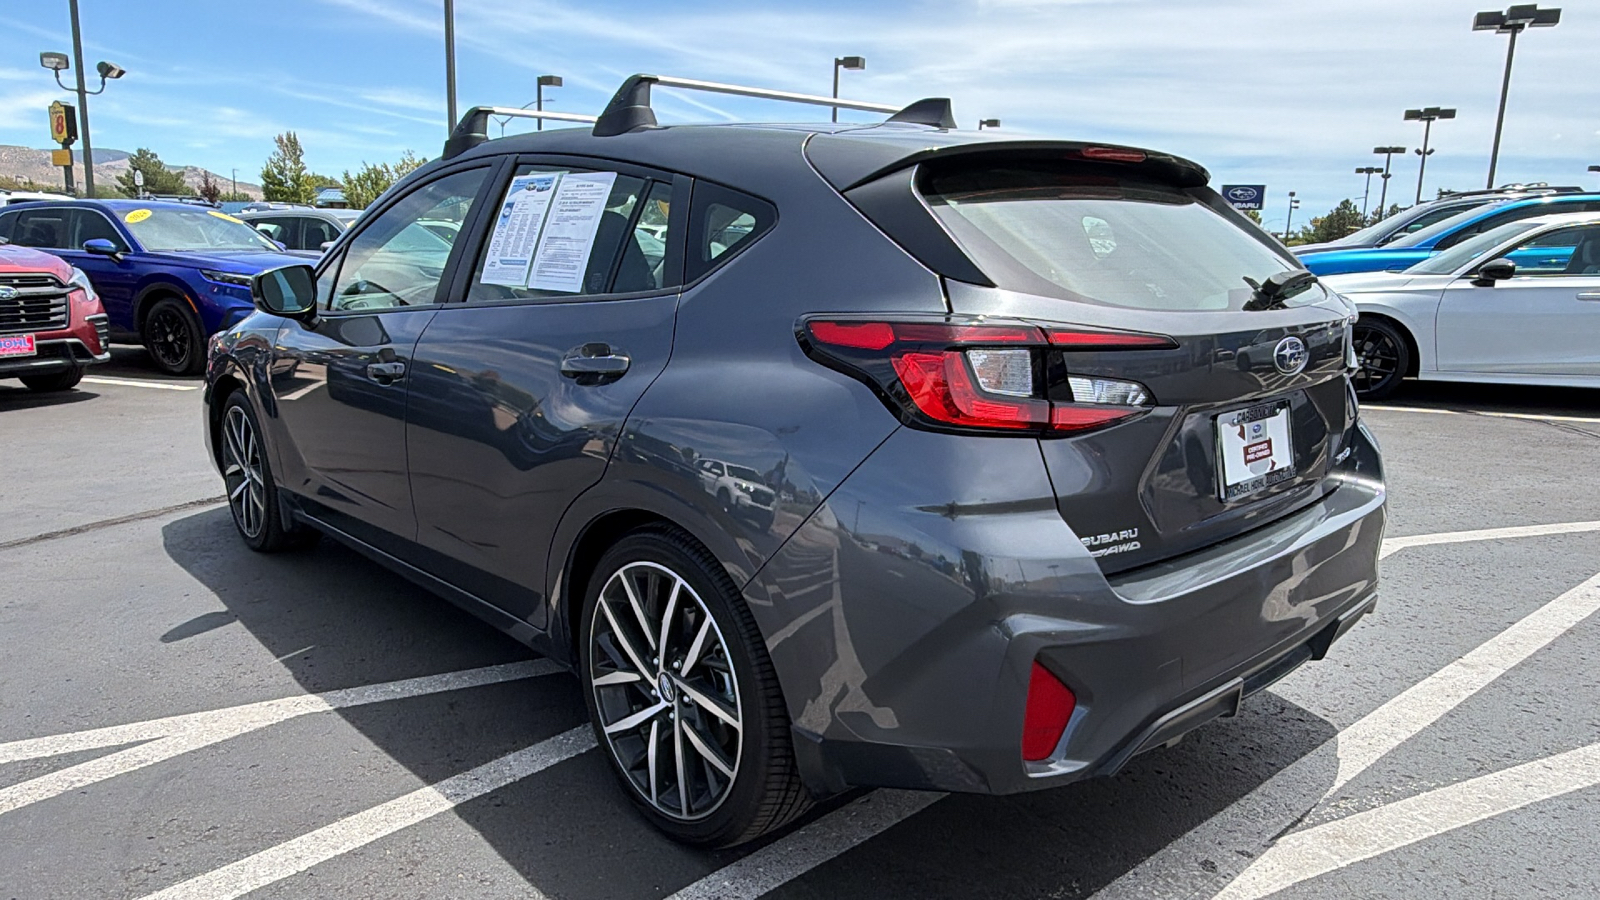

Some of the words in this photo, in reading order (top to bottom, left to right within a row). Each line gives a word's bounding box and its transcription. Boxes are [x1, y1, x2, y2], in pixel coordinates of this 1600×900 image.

[55, 115, 64, 134] 8
[0, 338, 30, 348] OHL
[1080, 528, 1138, 547] SUBARU
